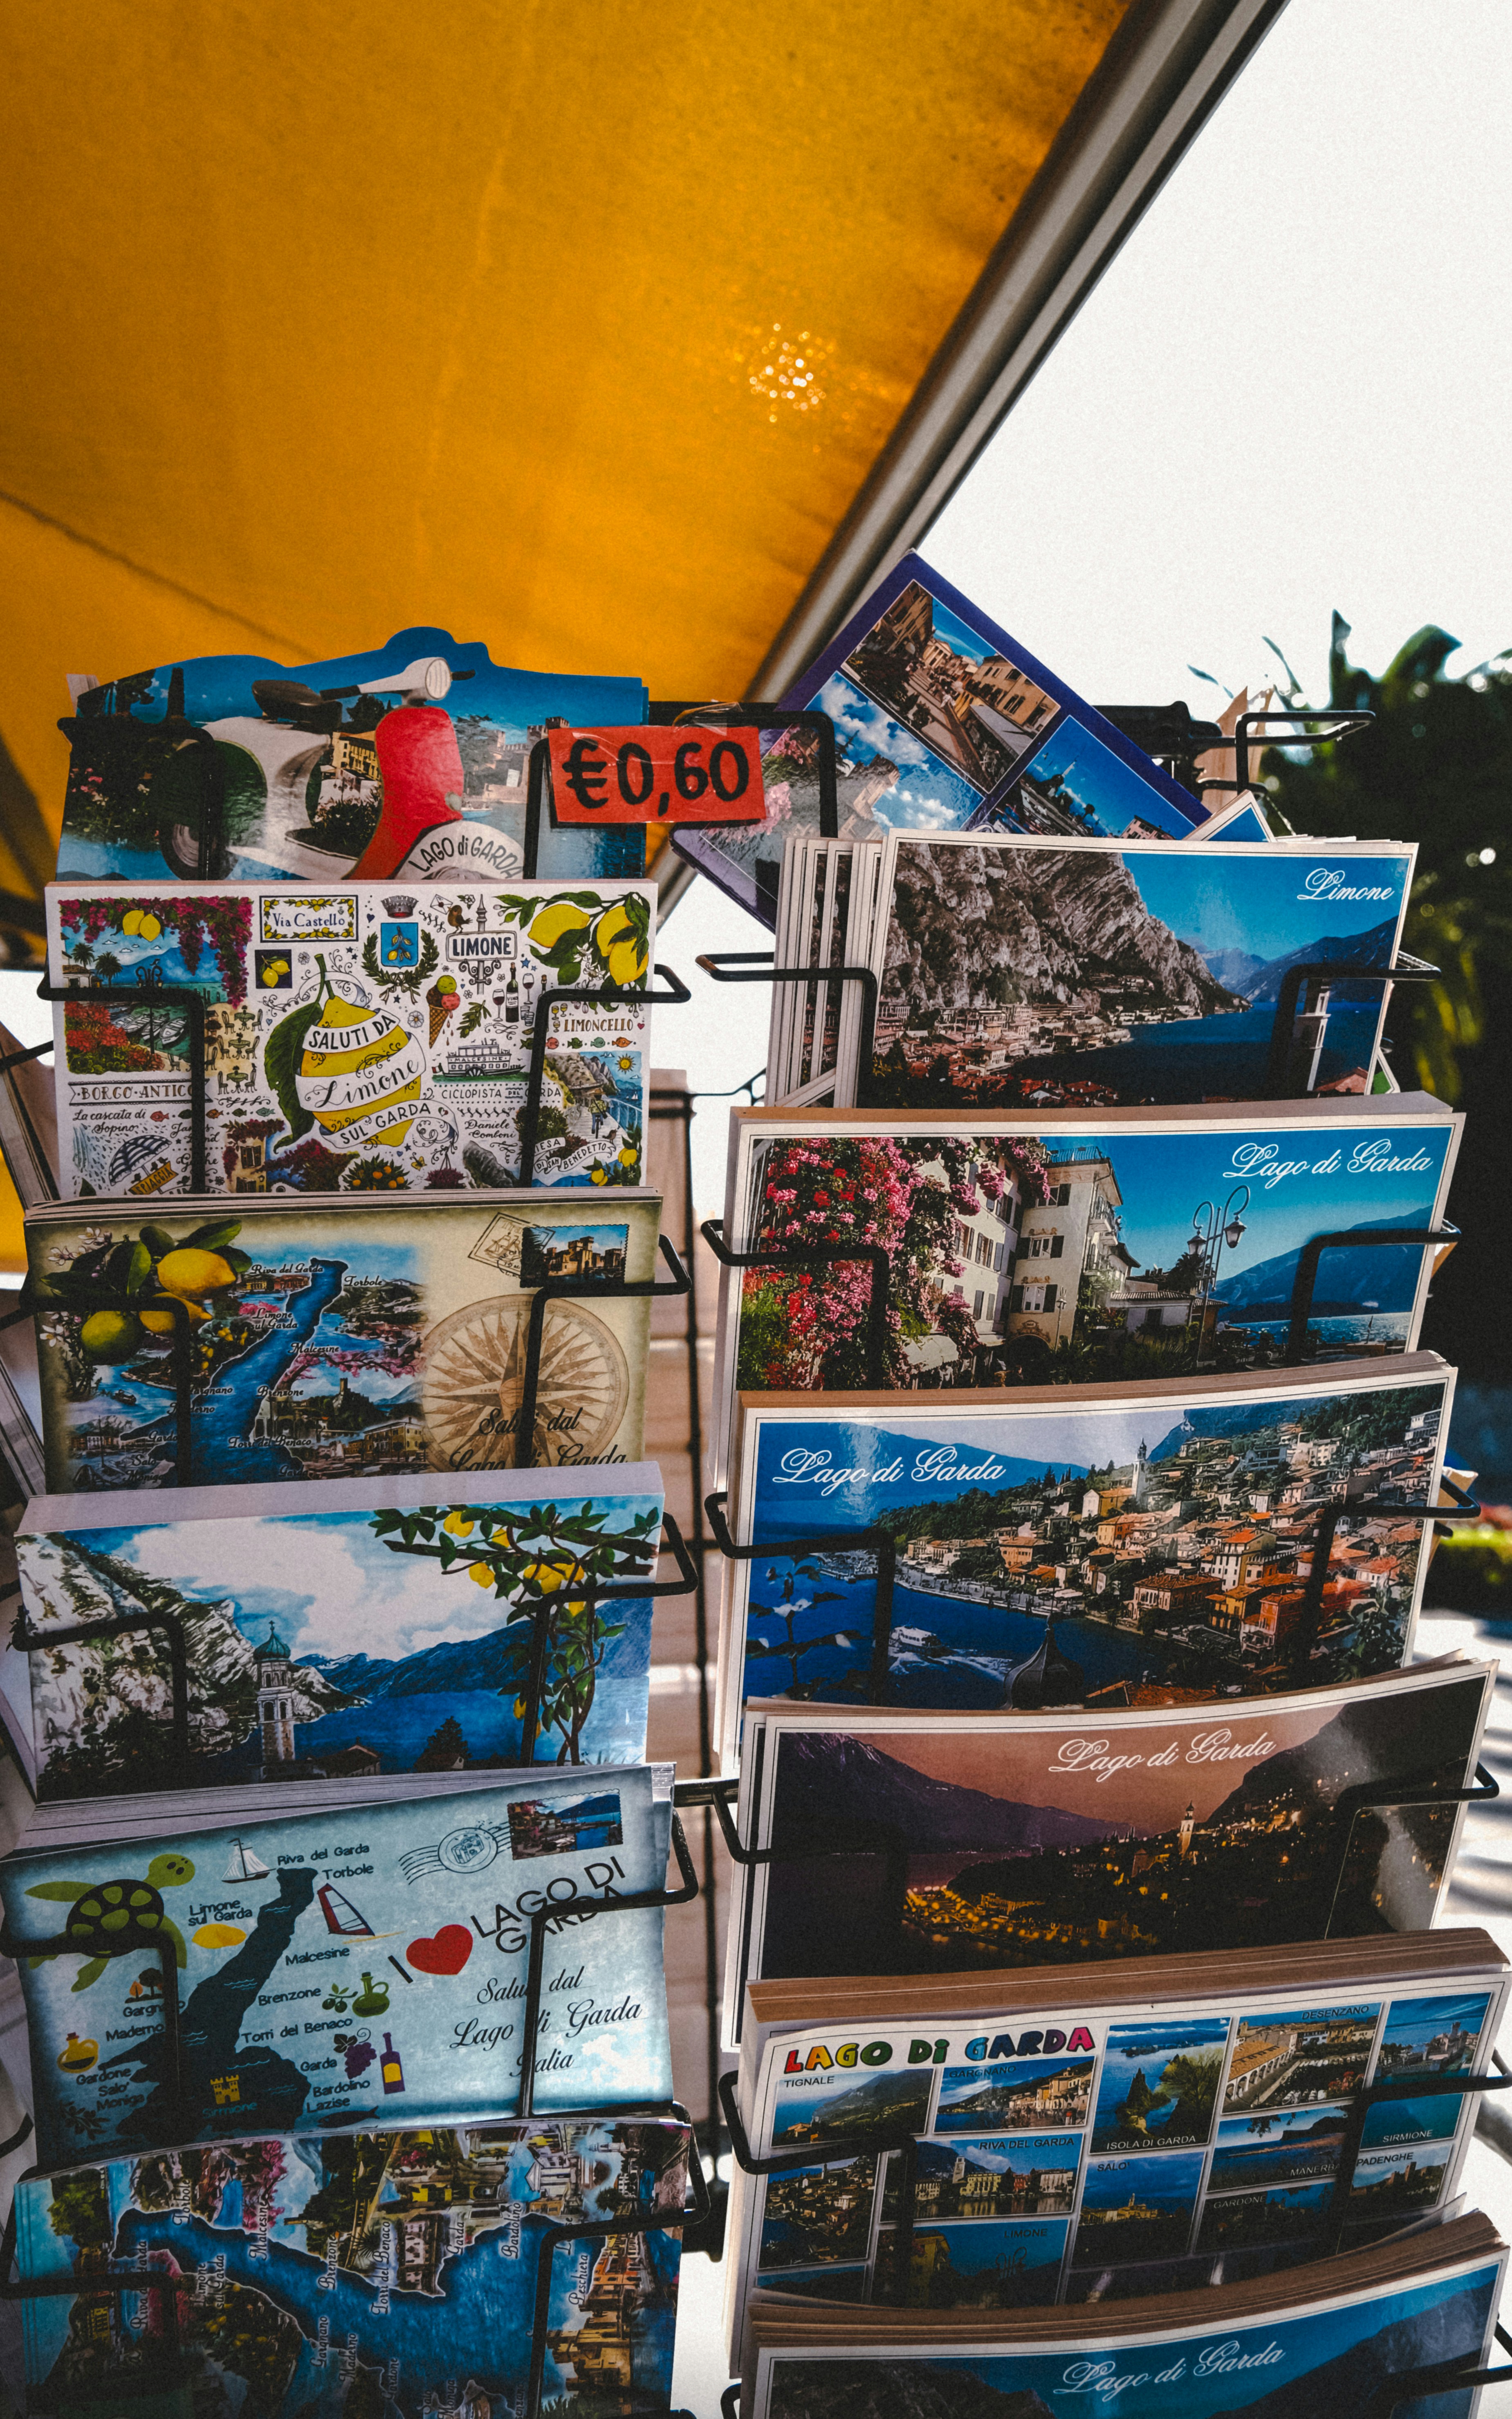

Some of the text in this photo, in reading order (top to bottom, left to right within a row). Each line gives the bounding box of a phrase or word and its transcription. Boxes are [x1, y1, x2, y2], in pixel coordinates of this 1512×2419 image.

[562, 738, 749, 816] €0,60
[408, 835, 523, 879] LAGO di GARDA
[1297, 868, 1395, 900] Limone
[273, 913, 345, 927] Via Castello
[453, 936, 511, 956] LIMONE
[309, 1015, 396, 1049] SALUTI DA
[563, 1019, 633, 1032] LIMONCELLO
[305, 1060, 419, 1108] Limone
[81, 1086, 133, 1100] BORGO
[442, 1088, 502, 1099] CICLOPISTA
[525, 1088, 561, 1098] RDA
[72, 1109, 146, 1121] La cascata di
[340, 1103, 431, 1144] SUL GARDA
[464, 1119, 511, 1129] Daniele
[469, 1130, 516, 1138] Comboni
[535, 1139, 561, 1152] IESA
[563, 1142, 607, 1169] BENEDETTO
[1223, 1138, 1433, 1189] Lago di Garda
[250, 1263, 324, 1275] Riva del Garda
[343, 1275, 383, 1287] Torbole
[252, 1308, 293, 1319] Limone
[267, 1317, 298, 1330] Garda
[288, 1342, 339, 1354] Malcesine
[191, 1387, 233, 1396] argnano
[256, 1385, 304, 1397] Brenzone
[547, 1407, 584, 1431] dal
[273, 1434, 312, 1447] Benaco
[772, 1446, 1007, 1497] Lago di Garda
[1048, 1728, 1277, 1782] Lago di Garda
[277, 1843, 370, 1866] Riva del Garda
[322, 1864, 375, 1880] Torbole
[189, 1899, 241, 1916] Limone
[214, 1907, 253, 1921] Garda
[387, 1856, 626, 1984] I LAGO DI
[285, 1946, 350, 1966] Malcesine
[477, 1966, 585, 2004] Salu dal
[258, 1988, 321, 2006] Brenzone
[123, 2000, 186, 2017] Gargno
[1302, 2005, 1370, 2020] DESENZANO
[241, 2017, 353, 2044] Torri del Benaco
[449, 2018, 514, 2051] Lago
[566, 1995, 642, 2038] Garda
[105, 2023, 164, 2042] Maderno
[783, 2040, 893, 2074] LAGO
[965, 2026, 1096, 2062] GARDA
[300, 2057, 338, 2072] Garda
[949, 2065, 1017, 2079] GARGNANO
[76, 2068, 132, 2085] Gardone
[784, 2076, 835, 2088] TIGNALE
[312, 2080, 371, 2098] Bardolino
[96, 2093, 145, 2112] Moniga
[202, 2102, 258, 2119] Sirmione
[307, 2097, 351, 2114] Lazise
[979, 2136, 1075, 2151] RIVA DEL GARDA
[1106, 2135, 1196, 2151] ISOLA DI GARDA
[1382, 2129, 1433, 2143] SIRMIONE
[1097, 2162, 1131, 2173] SALO'
[1356, 2152, 1415, 2167] PADENGHE
[1290, 2161, 1341, 2177] MANERBA
[172, 2179, 191, 2226] Torbole
[1213, 2195, 1266, 2209] GARDONE
[249, 2199, 268, 2261] Malcesine
[446, 2221, 465, 2255] Garda
[501, 2202, 521, 2259] Bardolino
[1004, 2227, 1048, 2239] LIMONE
[372, 2221, 391, 2264] Benaco
[317, 2235, 337, 2290] Brenzone
[377, 2266, 389, 2282] del
[568, 2255, 588, 2305] Peschiera
[130, 2299, 148, 2329] Riva
[310, 2316, 329, 2368] Gargnano
[1052, 2340, 1287, 2402] Lago di Garda
